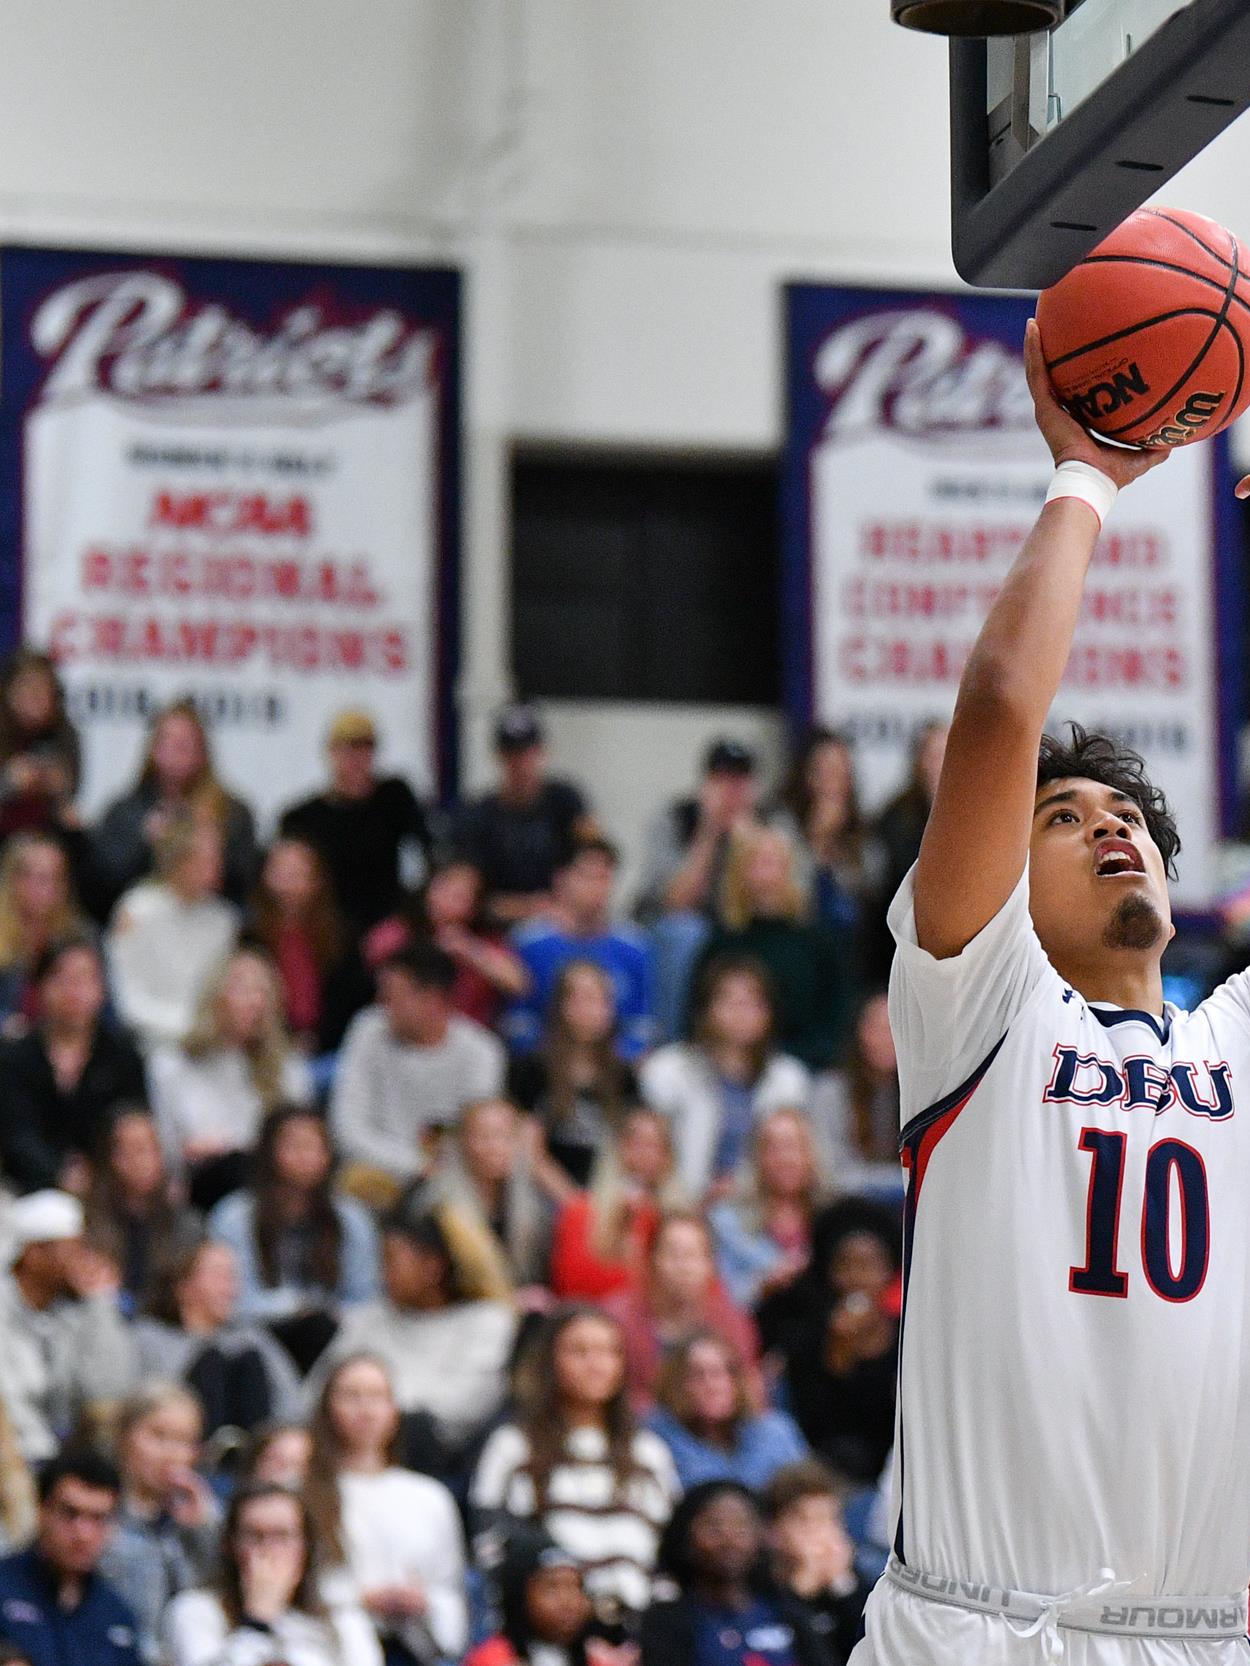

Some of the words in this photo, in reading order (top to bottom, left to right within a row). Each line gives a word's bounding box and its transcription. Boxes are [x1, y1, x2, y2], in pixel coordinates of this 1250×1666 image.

[30, 268, 440, 410] Patriots
[150, 490, 310, 537] NCAA
[864, 522, 1170, 566] HEARTND
[82, 548, 382, 606] REGIONAL
[845, 580, 1179, 626] CONFENCE
[50, 612, 410, 680] CHAMPIONS
[844, 638, 1188, 692] CHAONS
[1042, 1042, 1235, 1122] DBU
[1068, 1126, 1211, 1304] 10
